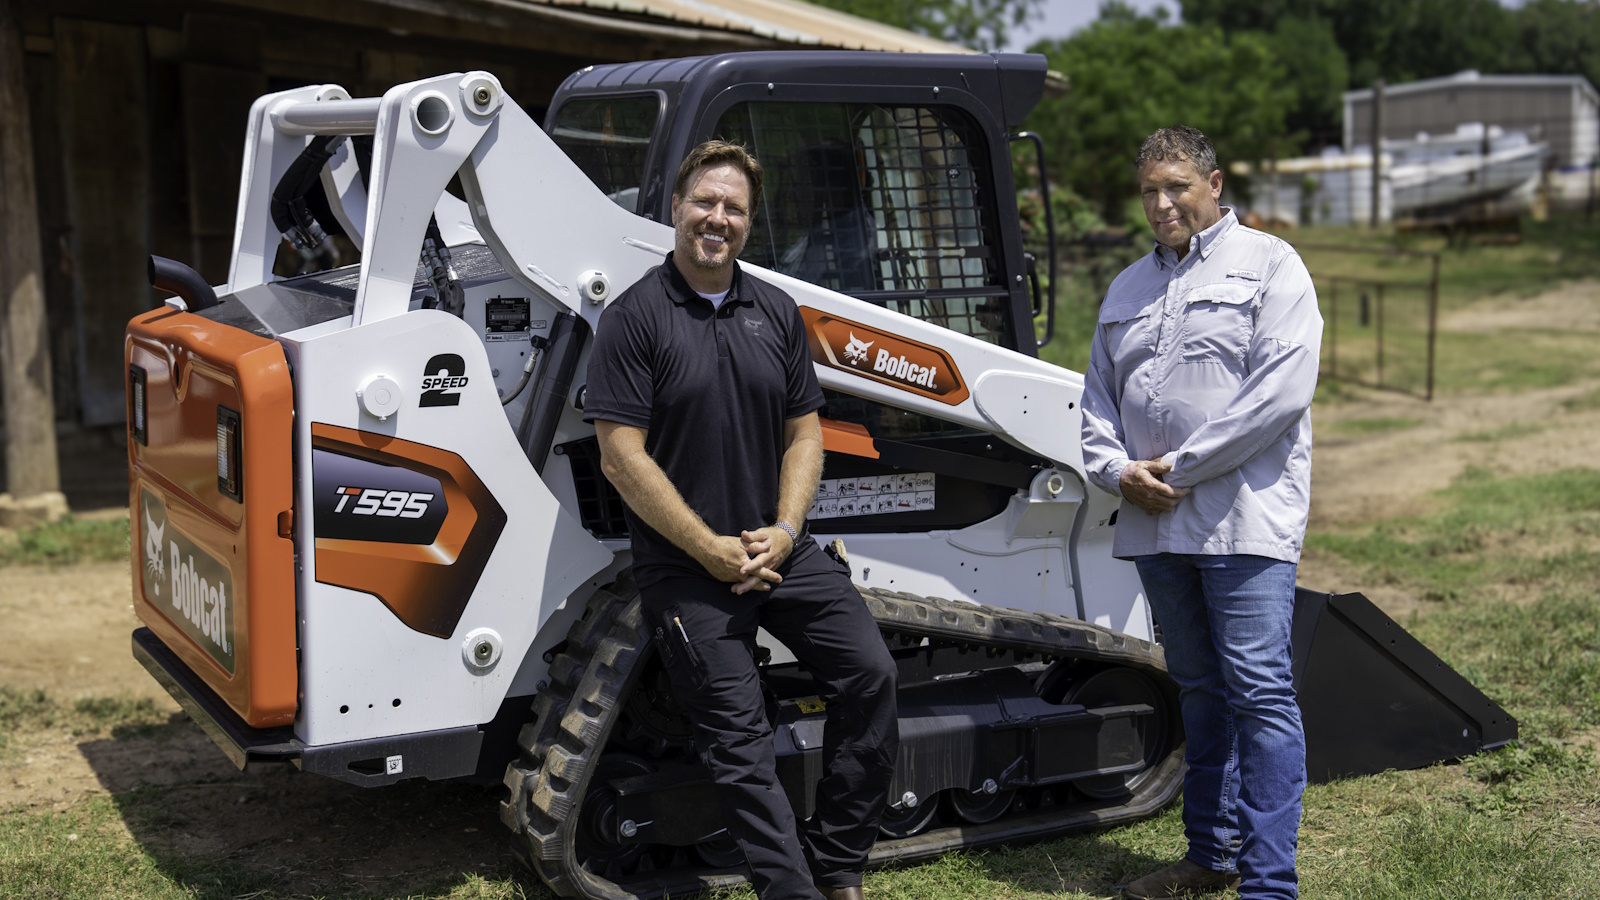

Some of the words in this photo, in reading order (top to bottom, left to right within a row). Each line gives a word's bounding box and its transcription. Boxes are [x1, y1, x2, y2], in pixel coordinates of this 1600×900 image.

[418, 353, 466, 408] 2
[421, 377, 469, 389] SPEED
[873, 348, 937, 389] Bobcat
[334, 486, 434, 519] T595
[170, 540, 228, 654] Bobcat
